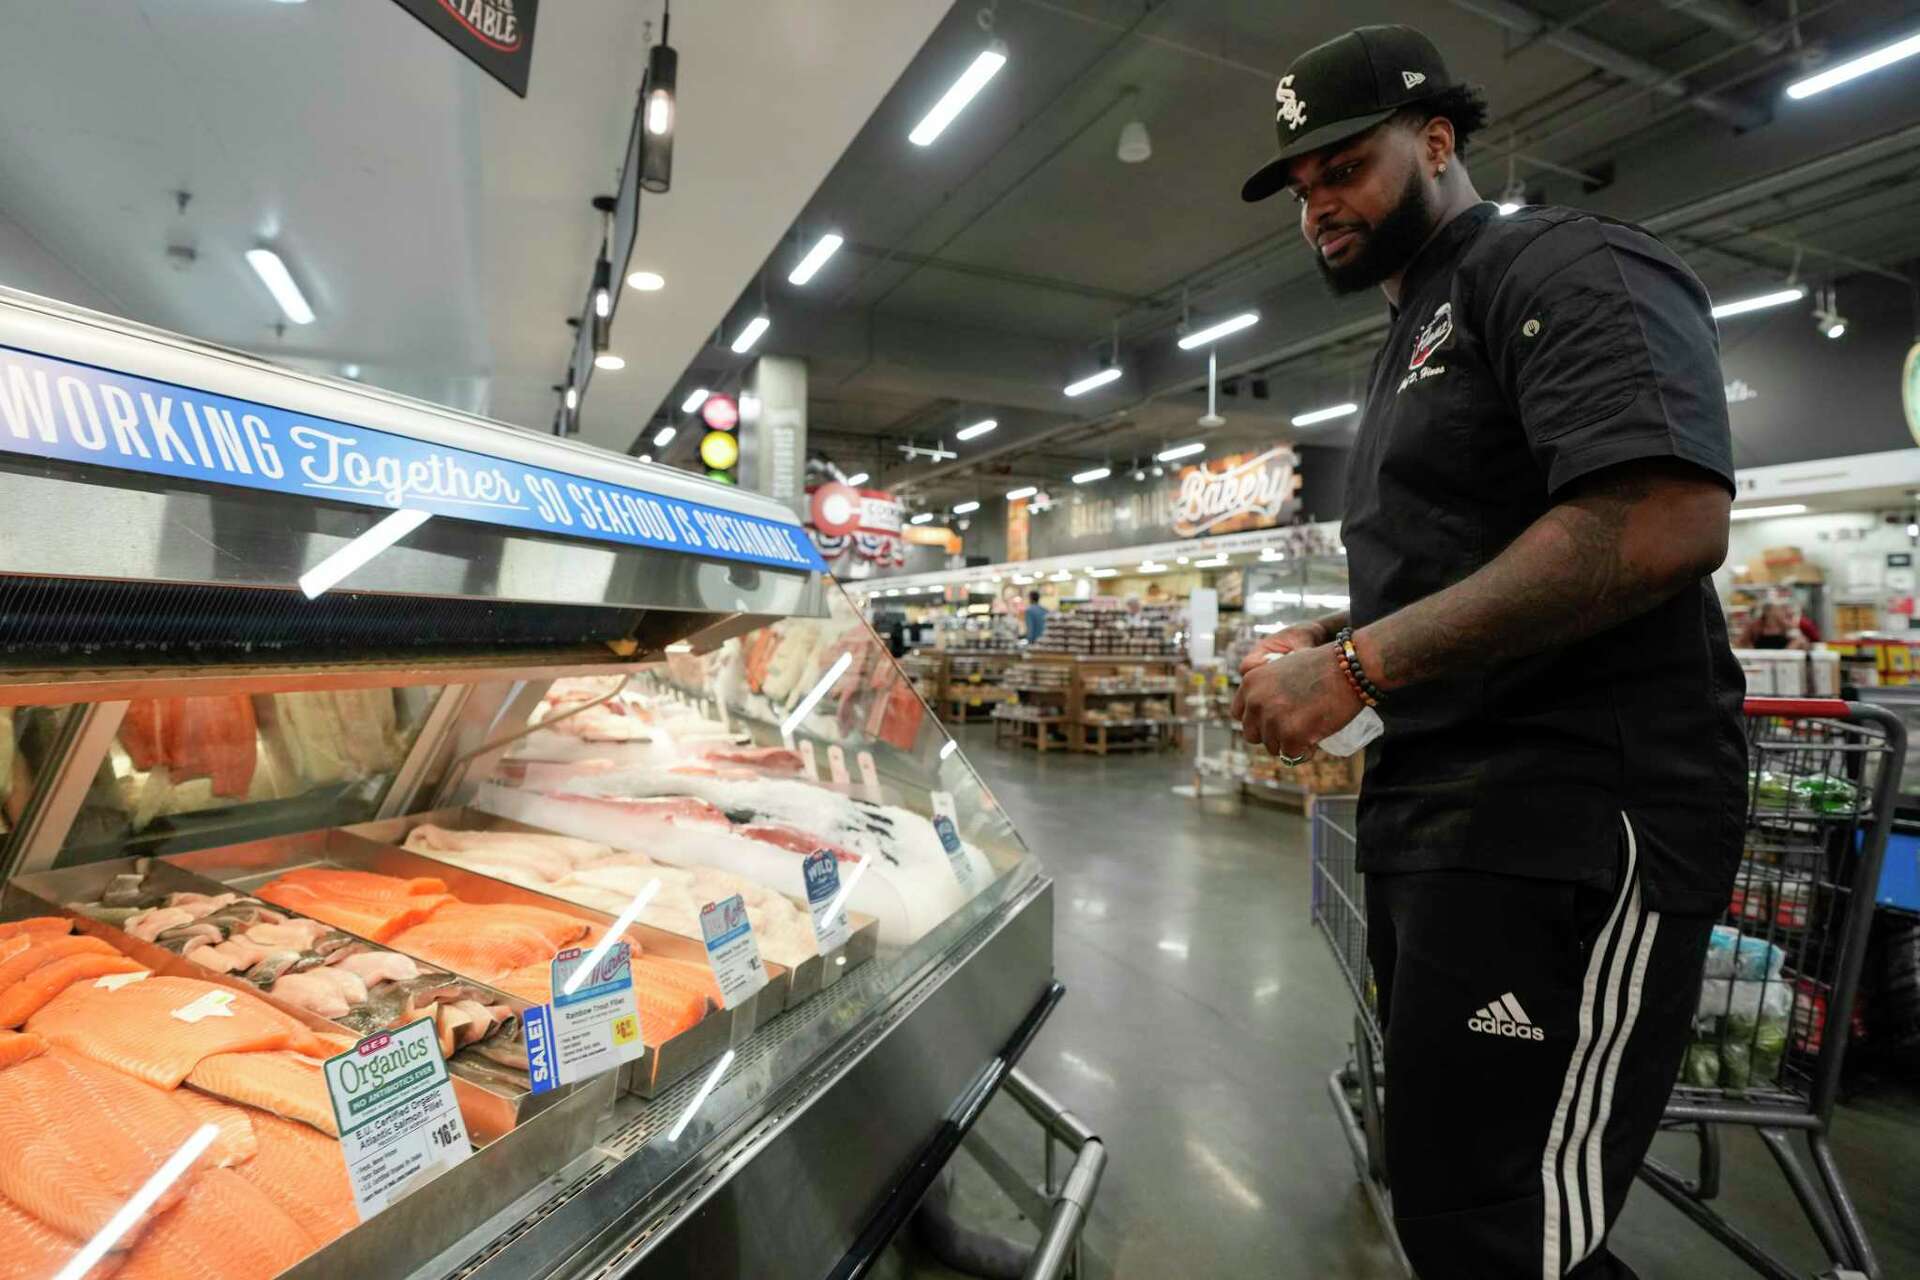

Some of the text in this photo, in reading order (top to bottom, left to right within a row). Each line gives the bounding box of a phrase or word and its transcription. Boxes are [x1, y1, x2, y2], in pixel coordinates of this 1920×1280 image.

[0, 363, 285, 480] WORKING
[289, 426, 521, 507] Together
[523, 473, 573, 526] SO
[567, 483, 677, 543] SEAFOOD
[668, 504, 702, 547] IS
[1172, 450, 1297, 535] Bakery
[808, 858, 833, 883] WILD
[1467, 1017, 1544, 1041] adidas
[340, 1038, 428, 1094] Organics
[527, 1017, 549, 1083] SALE!
[352, 1098, 368, 1111] NO
[375, 1105, 411, 1130] Certified
[410, 1090, 441, 1110] Organic
[361, 1127, 392, 1149] Atlantic
[393, 1110, 424, 1132] Salmon
